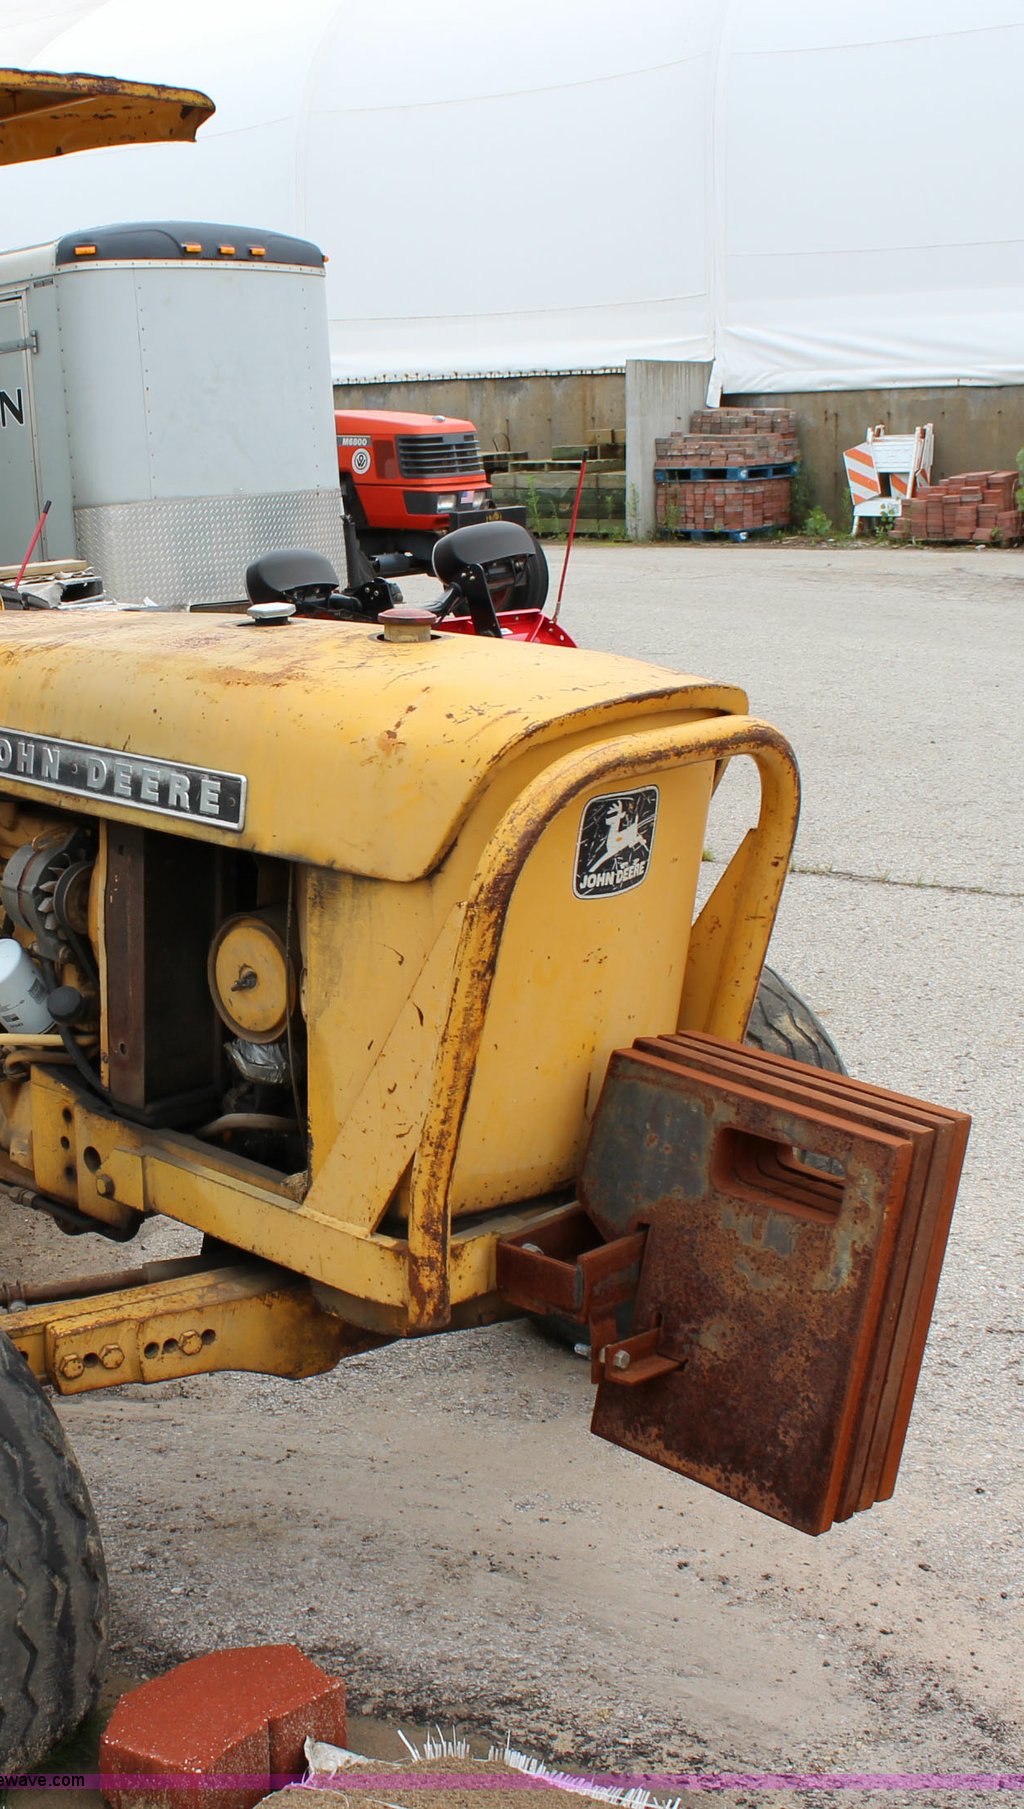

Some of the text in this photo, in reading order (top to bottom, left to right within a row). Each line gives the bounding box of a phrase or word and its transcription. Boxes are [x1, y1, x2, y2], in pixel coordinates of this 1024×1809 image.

[342, 438, 368, 446] M6800
[87, 756, 222, 815] DEERE
[579, 860, 646, 889] JOHN DEERE
